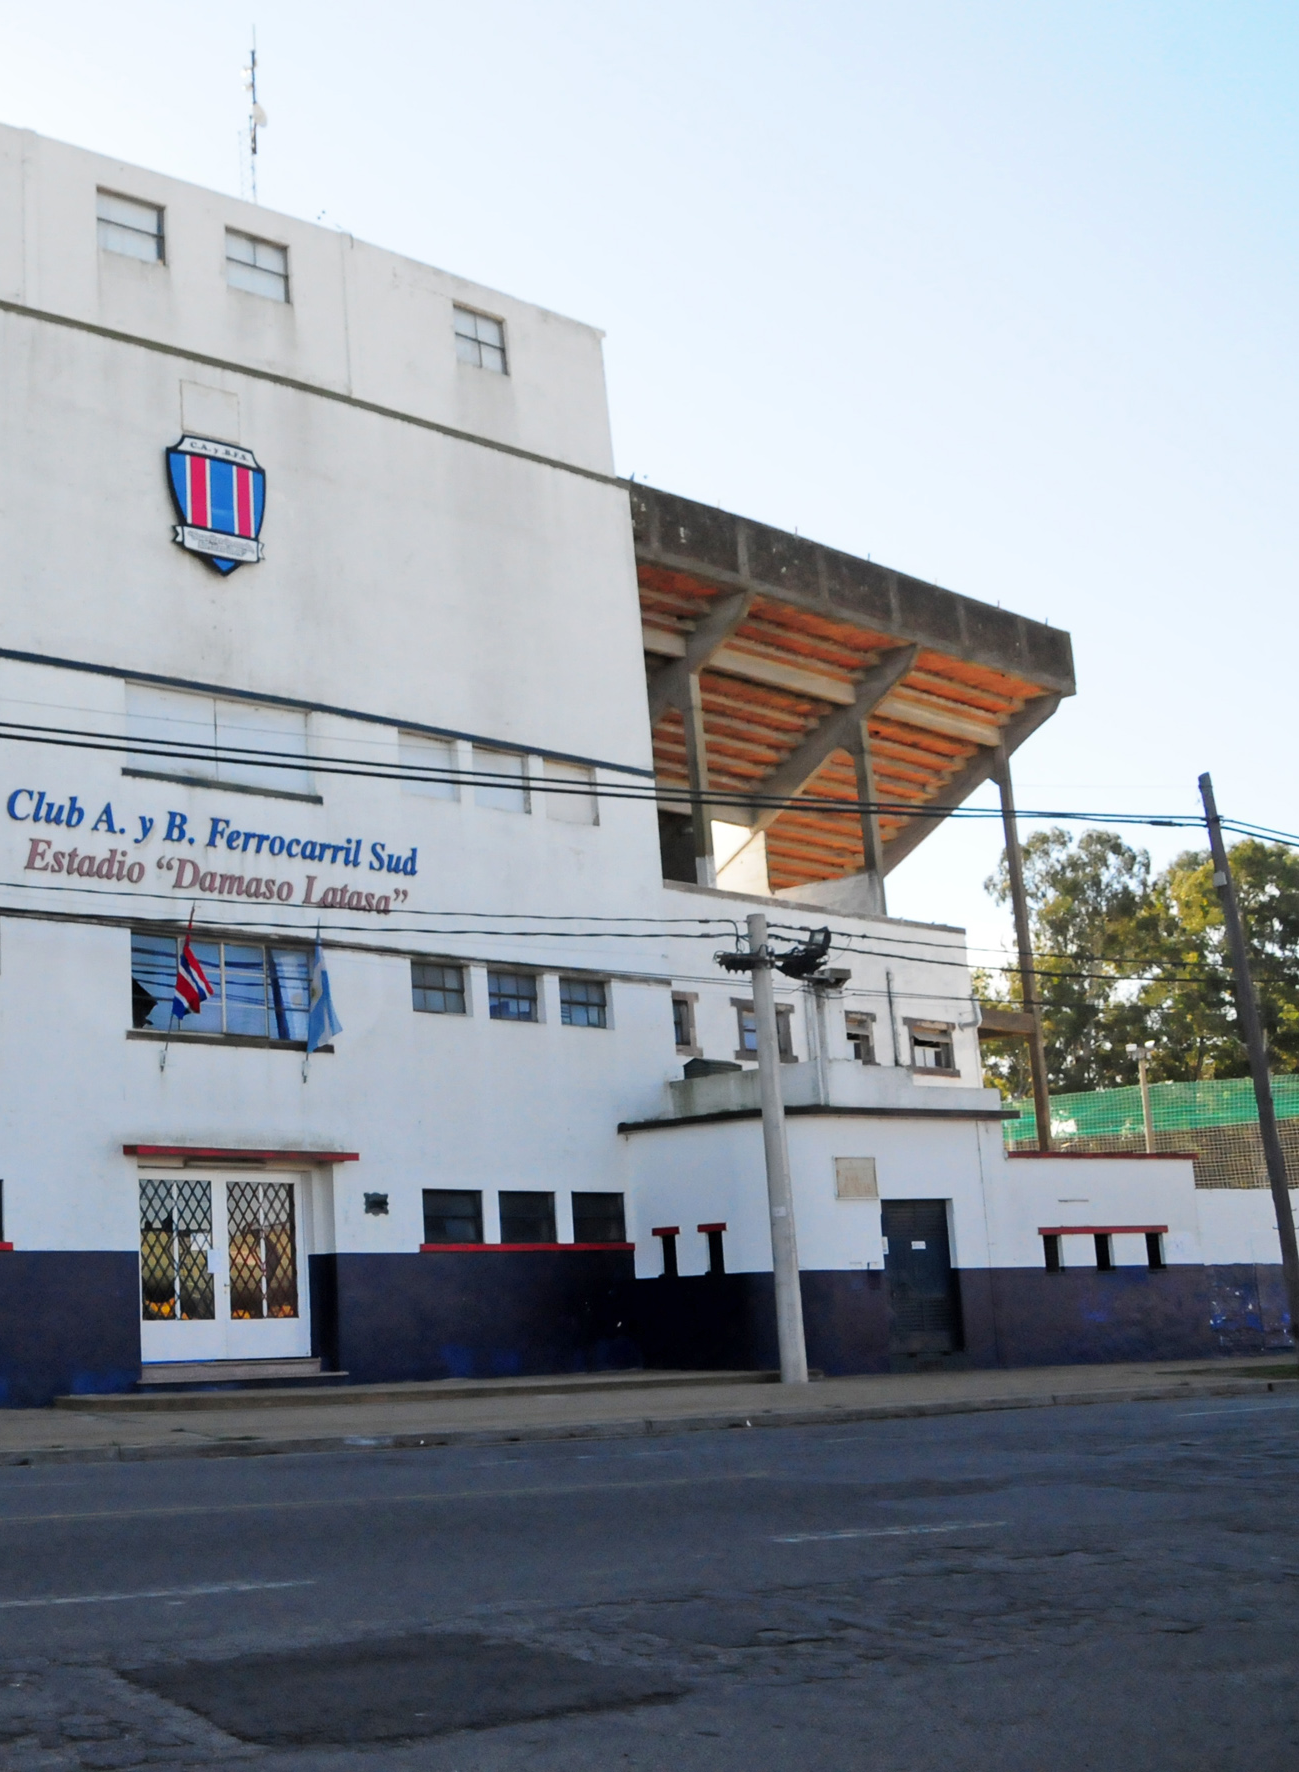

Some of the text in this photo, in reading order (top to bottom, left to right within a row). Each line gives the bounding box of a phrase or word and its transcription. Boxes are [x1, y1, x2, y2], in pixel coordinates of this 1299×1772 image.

[7, 788, 418, 876] Club A. y B. Ferrocarril Sud
[24, 838, 409, 915] Estadio “Damaso Latasa”
